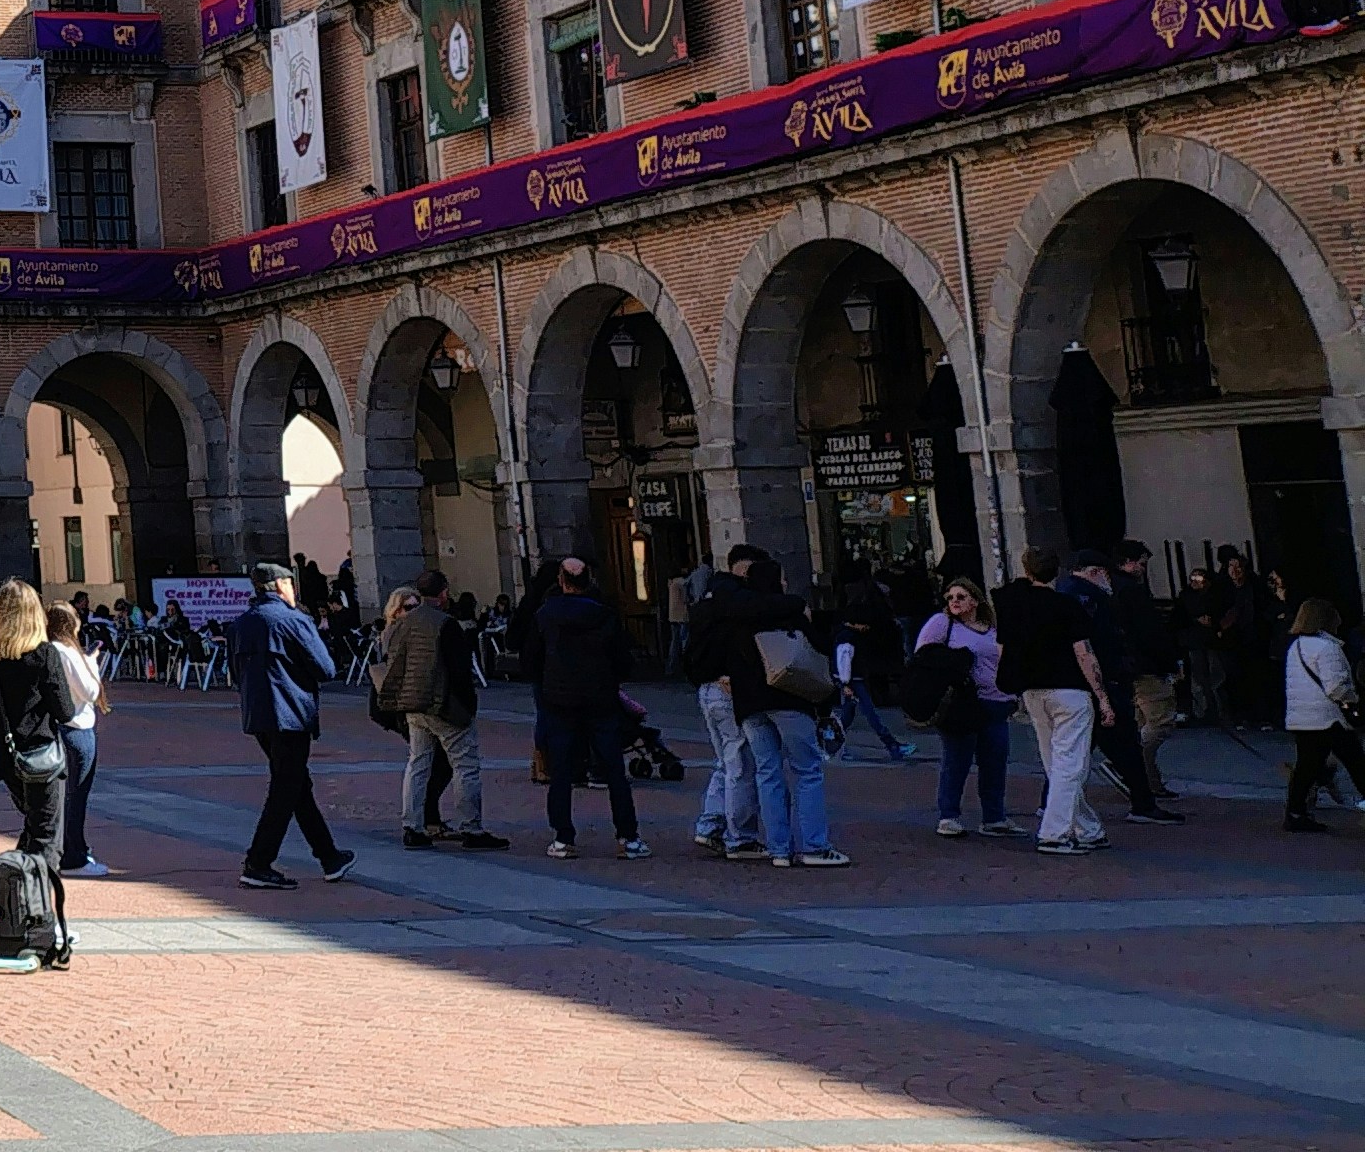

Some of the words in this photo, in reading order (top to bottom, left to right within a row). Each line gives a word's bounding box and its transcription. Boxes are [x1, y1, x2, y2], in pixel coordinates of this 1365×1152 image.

[973, 27, 1062, 67] Ayuntamiento
[972, 70, 990, 90] de
[993, 59, 1026, 87] Ávila
[813, 101, 873, 141] ÁVILA
[661, 124, 727, 152] Ayuntamiento
[660, 155, 673, 171] de
[675, 149, 701, 167] Ávila
[432, 186, 482, 210] Ayuntamiento
[549, 175, 590, 208] ÁVILA
[16, 259, 99, 273] Ayuntamiento
[16, 273, 32, 285] de
[34, 271, 65, 286] Ávila
[639, 481, 669, 497] CASA
[164, 589, 202, 599] Casa
[208, 588, 252, 600] Felipe
[186, 579, 228, 588] HOSTAL
